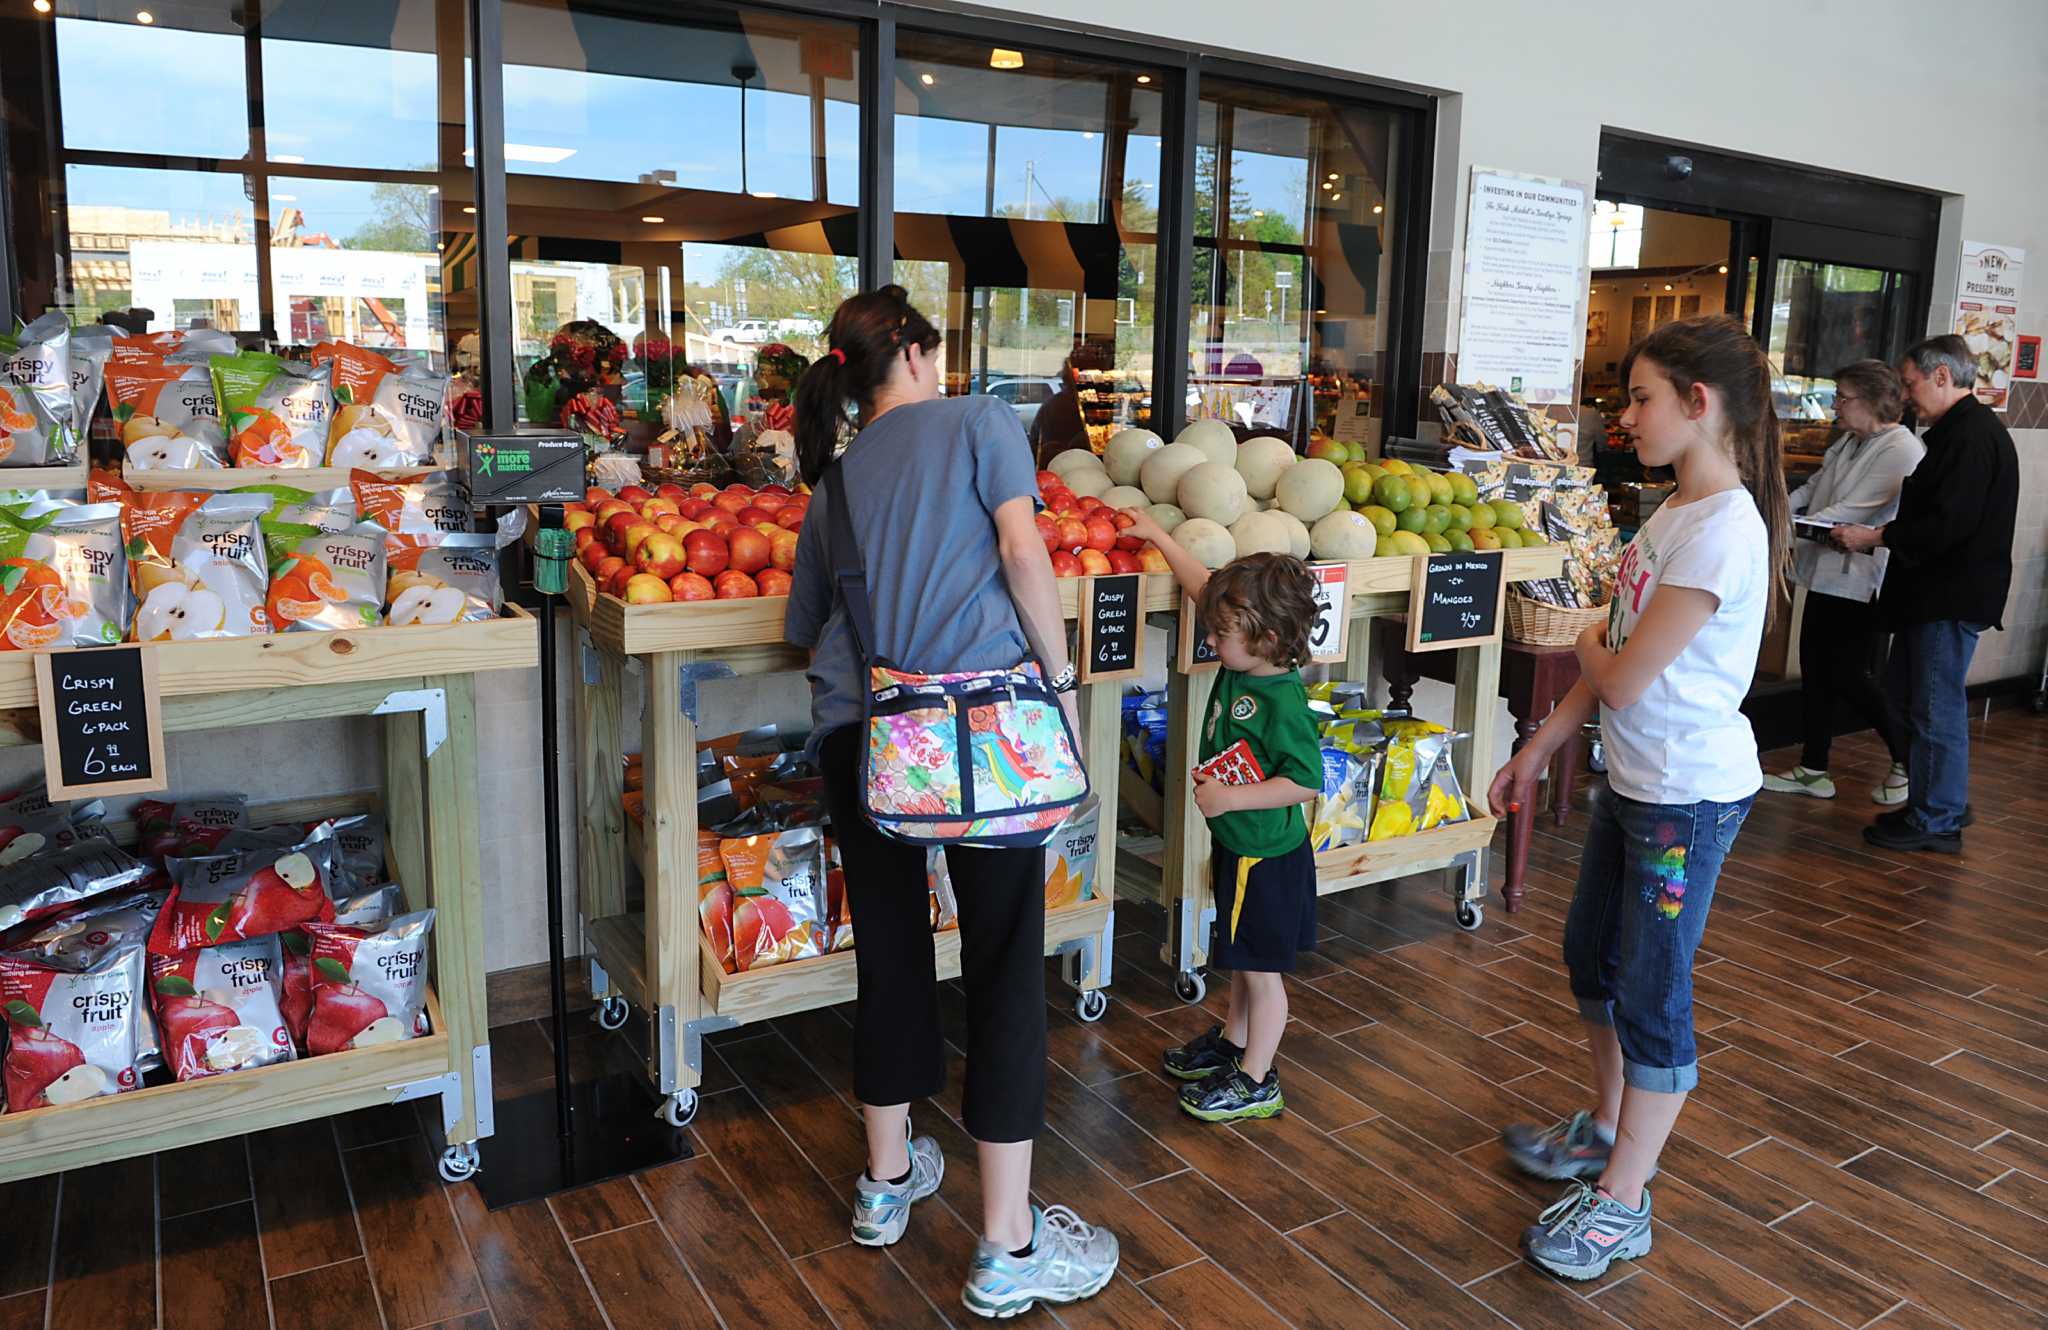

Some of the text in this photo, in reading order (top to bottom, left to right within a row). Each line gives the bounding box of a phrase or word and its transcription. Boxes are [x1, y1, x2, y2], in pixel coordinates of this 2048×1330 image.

[1483, 185, 1577, 207] INVESTING IN OUR COMMUNITIES
[1984, 255, 2002, 270] NEW
[1966, 281, 2015, 297] PRESSED WRAPS
[404, 404, 435, 422] fruit
[538, 441, 579, 449] Produce Bags
[497, 454, 530, 464] more
[433, 518, 466, 532] fruit
[332, 555, 368, 570] fruit
[1432, 592, 1473, 605] MANGOES
[1098, 608, 1127, 620] GREEN
[62, 674, 115, 691] CRISPY
[68, 700, 123, 715] GREEN
[82, 721, 131, 735] 6-PACK
[111, 763, 138, 772] EACH
[1070, 844, 1091, 857] fruit
[231, 971, 270, 988] fruit
[385, 964, 418, 981] fruit
[81, 1005, 123, 1024] fruit
